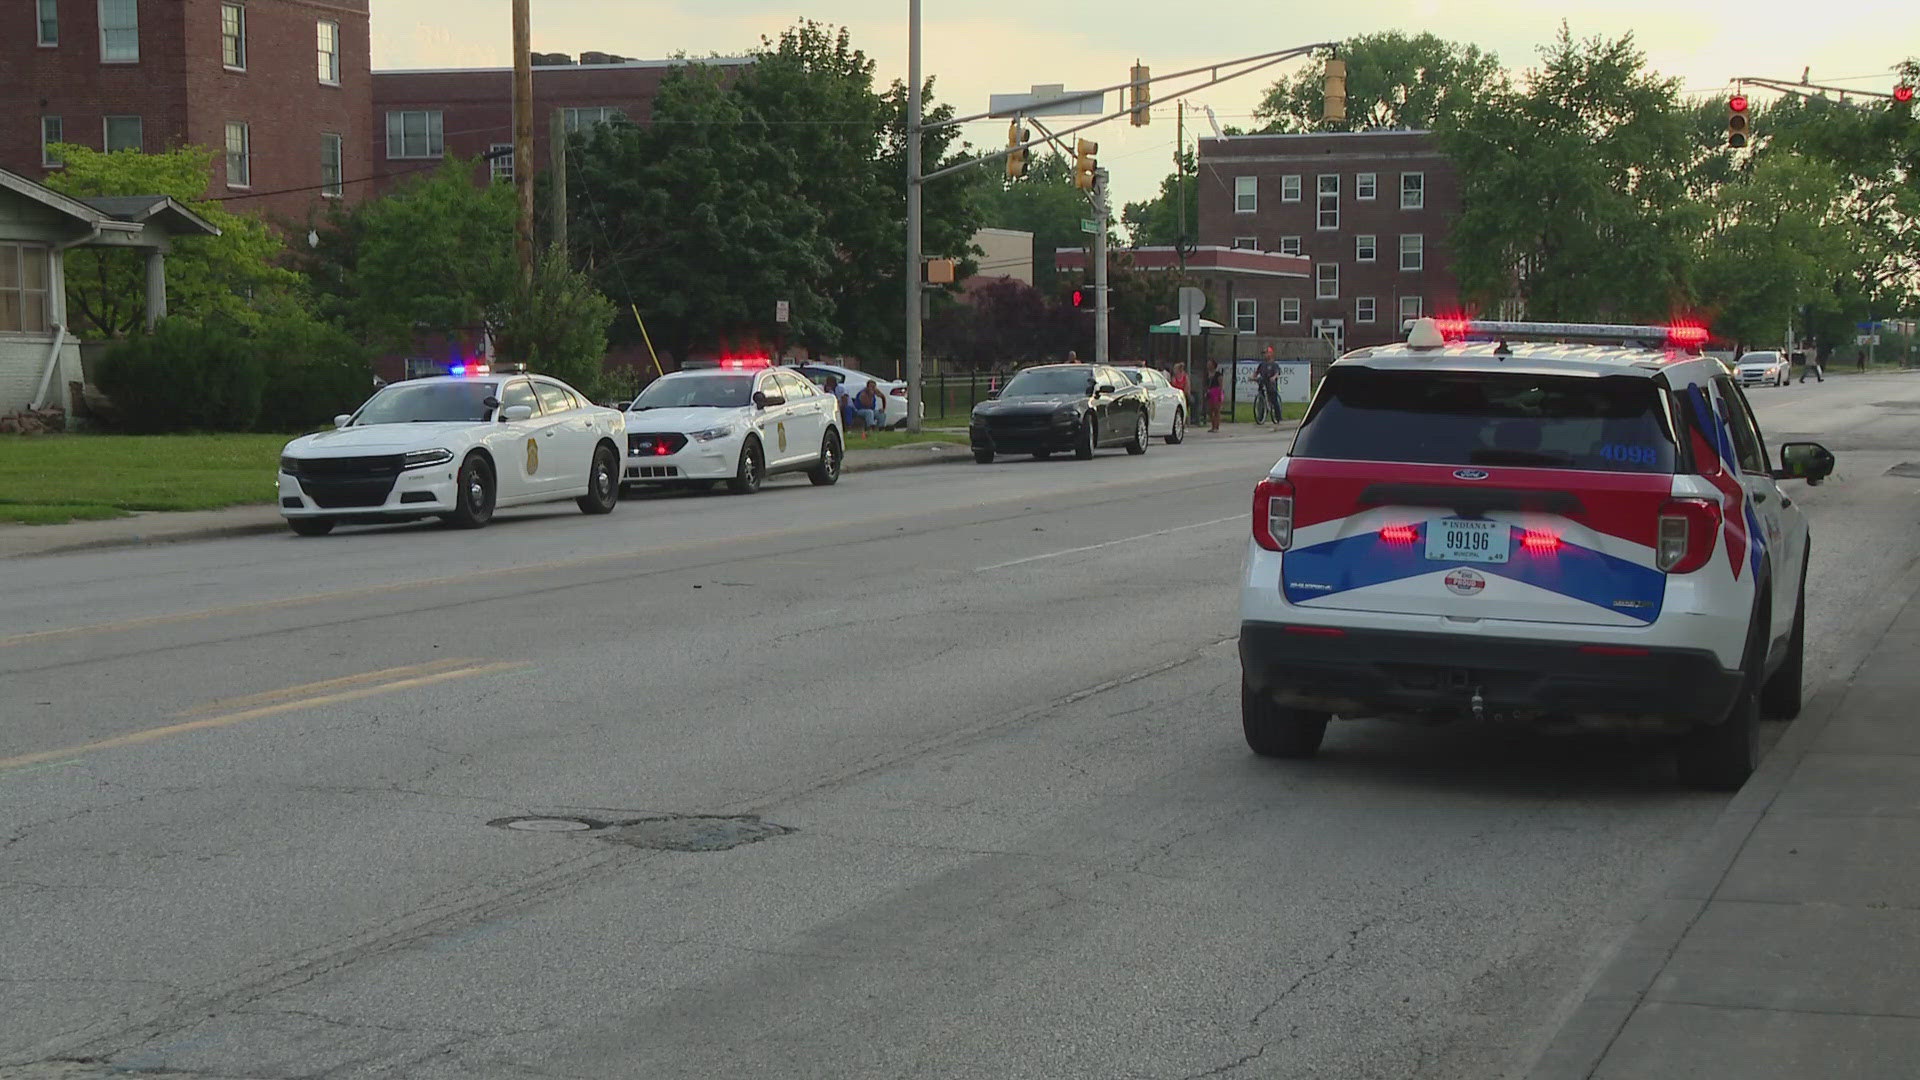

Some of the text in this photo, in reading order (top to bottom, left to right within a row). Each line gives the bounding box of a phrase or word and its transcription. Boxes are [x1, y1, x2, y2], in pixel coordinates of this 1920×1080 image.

[1600, 443, 1657, 465] 4098
[1450, 521, 1487, 529] INDIANA
[1446, 530, 1489, 550] 99196
